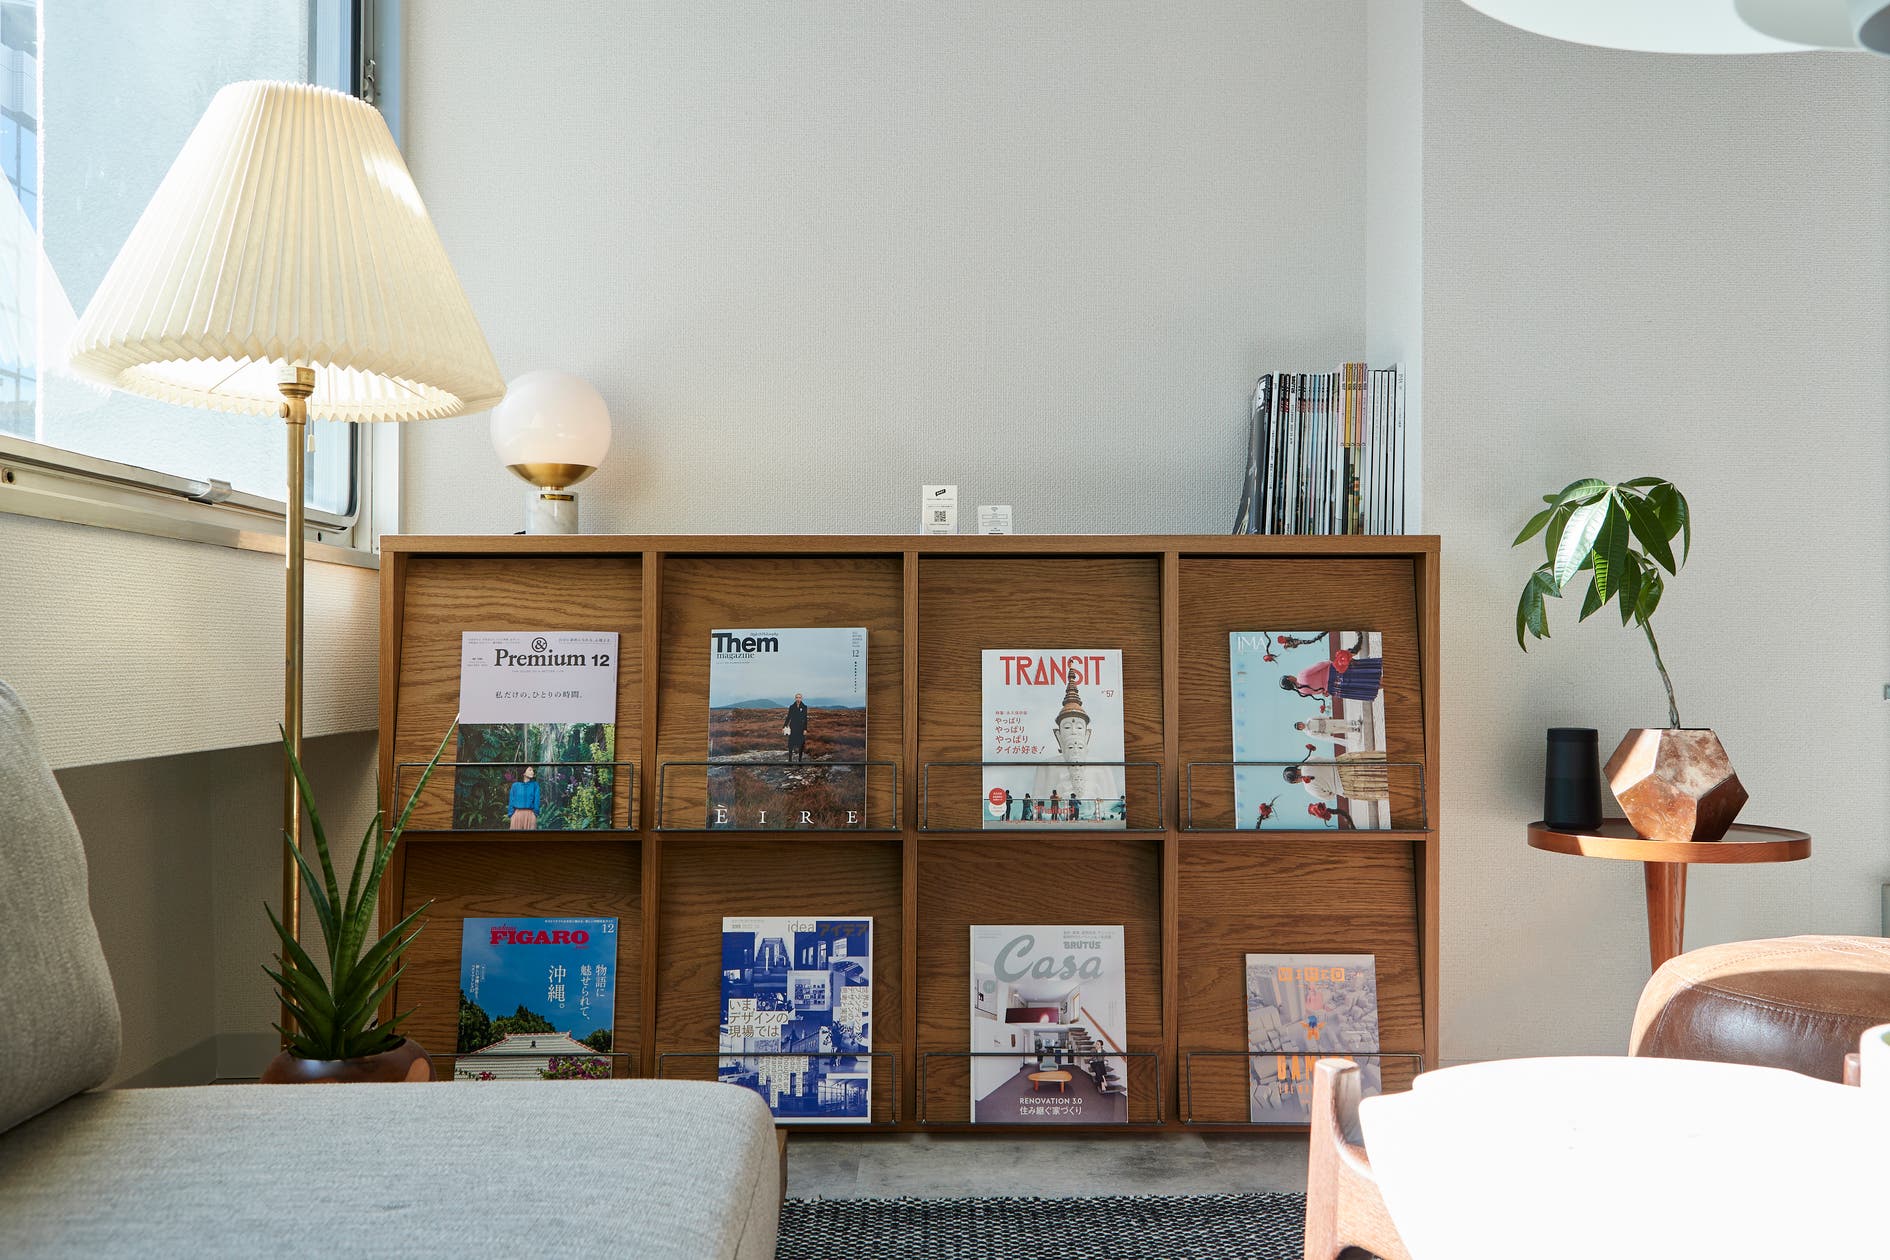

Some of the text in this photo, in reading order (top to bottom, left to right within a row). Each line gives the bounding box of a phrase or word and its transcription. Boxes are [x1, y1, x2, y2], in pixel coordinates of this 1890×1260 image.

[712, 632, 779, 653] Them
[1237, 636, 1266, 650] IMA
[494, 648, 586, 667] Premium
[591, 654, 610, 667] 12
[716, 652, 755, 660] magazine
[999, 655, 1105, 686] TRANSIT
[602, 924, 615, 934] 12
[787, 920, 815, 933] idea
[490, 930, 590, 945] FIGARO
[1063, 941, 1101, 950] BRUTUS
[994, 934, 1105, 983] Casa
[548, 964, 567, 1009] 沖縄。
[595, 964, 607, 998] 物語に
[729, 1012, 788, 1025] デザインの
[728, 1025, 780, 1038] 現場では
[1019, 1097, 1083, 1105] RENOVATION 3.0
